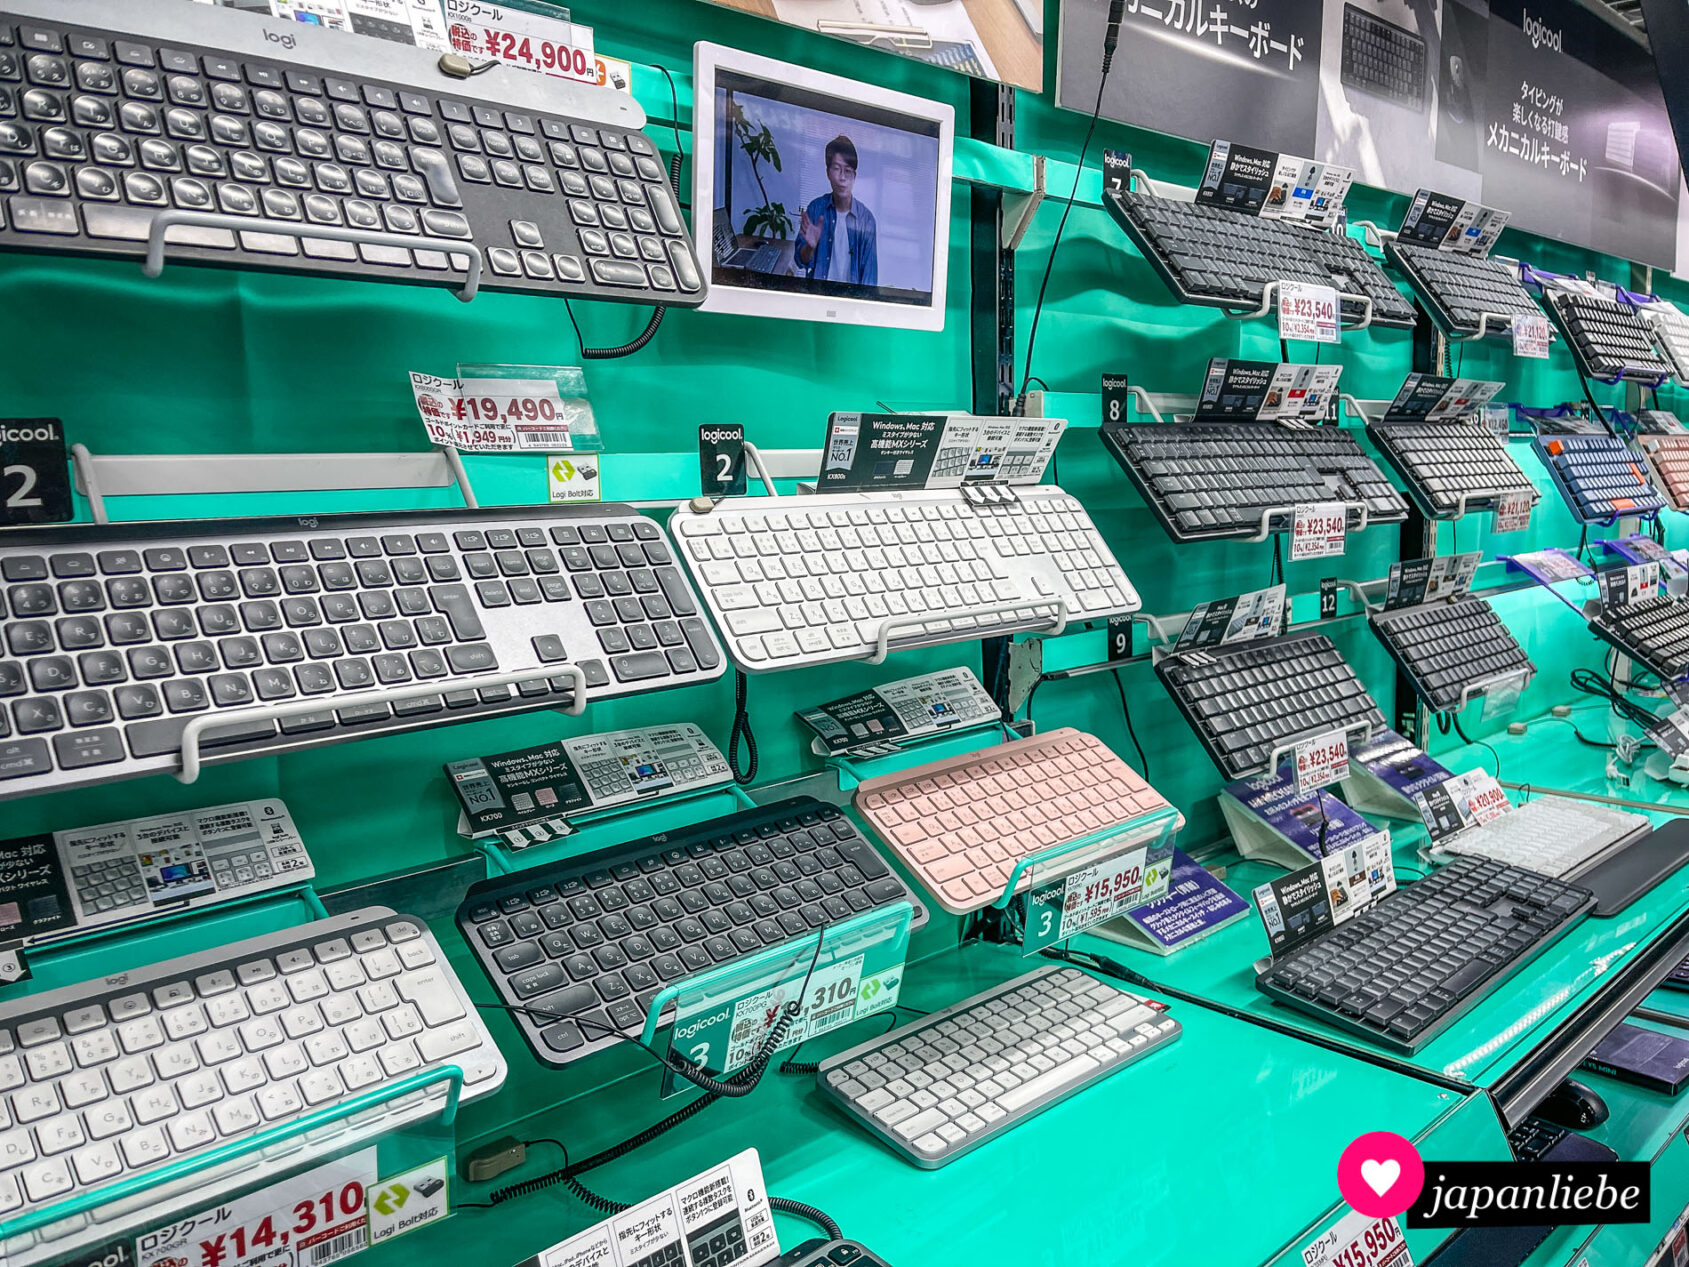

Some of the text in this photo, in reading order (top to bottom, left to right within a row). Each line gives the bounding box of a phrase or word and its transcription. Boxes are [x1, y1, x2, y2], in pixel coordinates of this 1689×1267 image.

[263, 28, 297, 49] logi
[1523, 8, 1562, 53] logicool
[1521, 80, 1563, 116] タイピングが
[1513, 102, 1569, 144] 楽しくなる打鍵感
[1487, 121, 1587, 182] メカニカルキーボード
[1111, 177, 1122, 190] 7
[412, 373, 464, 390] ロジクール
[1109, 400, 1120, 421] 8
[0, 424, 55, 447] icool
[701, 428, 742, 446] logicool
[716, 454, 733, 481] 2
[3, 465, 43, 507] 2
[298, 518, 318, 528] logi
[1322, 594, 1335, 612] 12
[1116, 635, 1125, 653] 9
[1032, 884, 1065, 906] logicool
[1038, 910, 1053, 937] 3
[674, 1008, 730, 1040] logicool
[690, 1042, 710, 1072] 3
[141, 1207, 232, 1251] ロジクール
[374, 1206, 439, 1240] Logi Bolt対応
[619, 1208, 672, 1241] 指先にフィットする
[635, 1223, 662, 1242] キー形状
[1304, 1231, 1337, 1264] ロジクール
